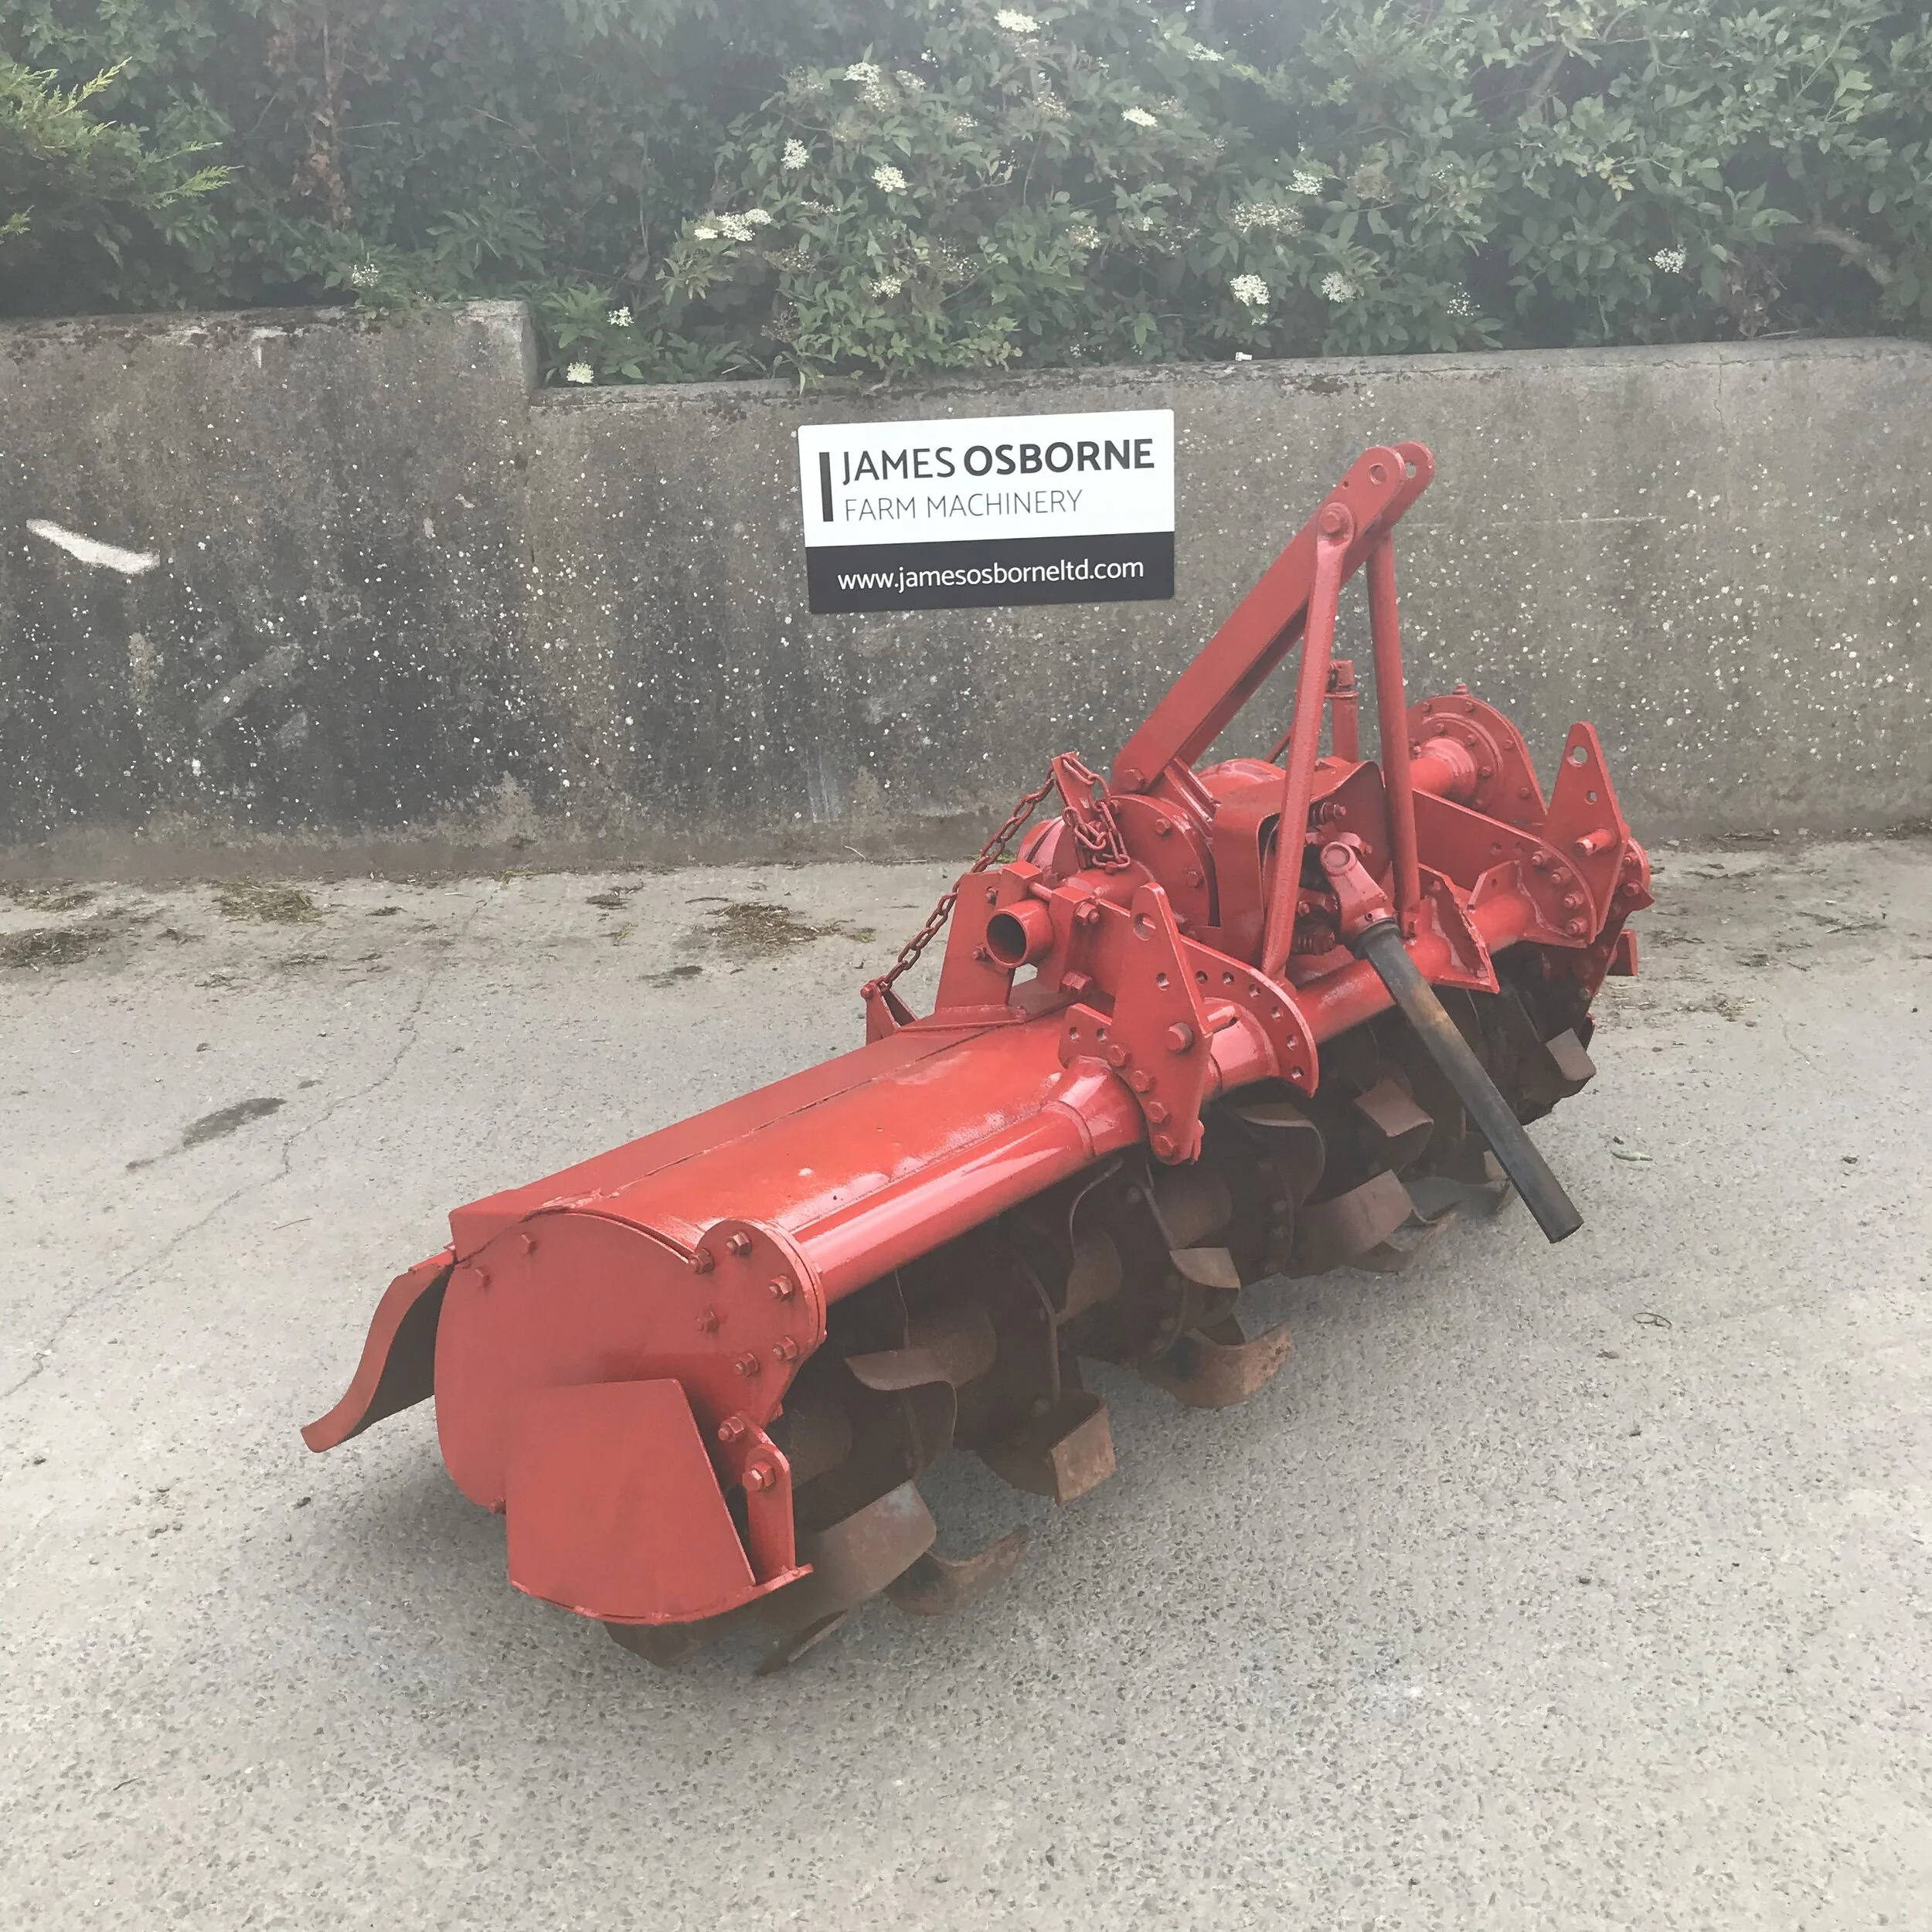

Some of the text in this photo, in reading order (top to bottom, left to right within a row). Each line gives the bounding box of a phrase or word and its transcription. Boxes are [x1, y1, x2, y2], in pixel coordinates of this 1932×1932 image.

[842, 438, 1155, 485] JAMES OSBORNE
[845, 489, 1083, 522] FARM MACHINERY
[837, 559, 1145, 593] www.jamesosborneltd.com
